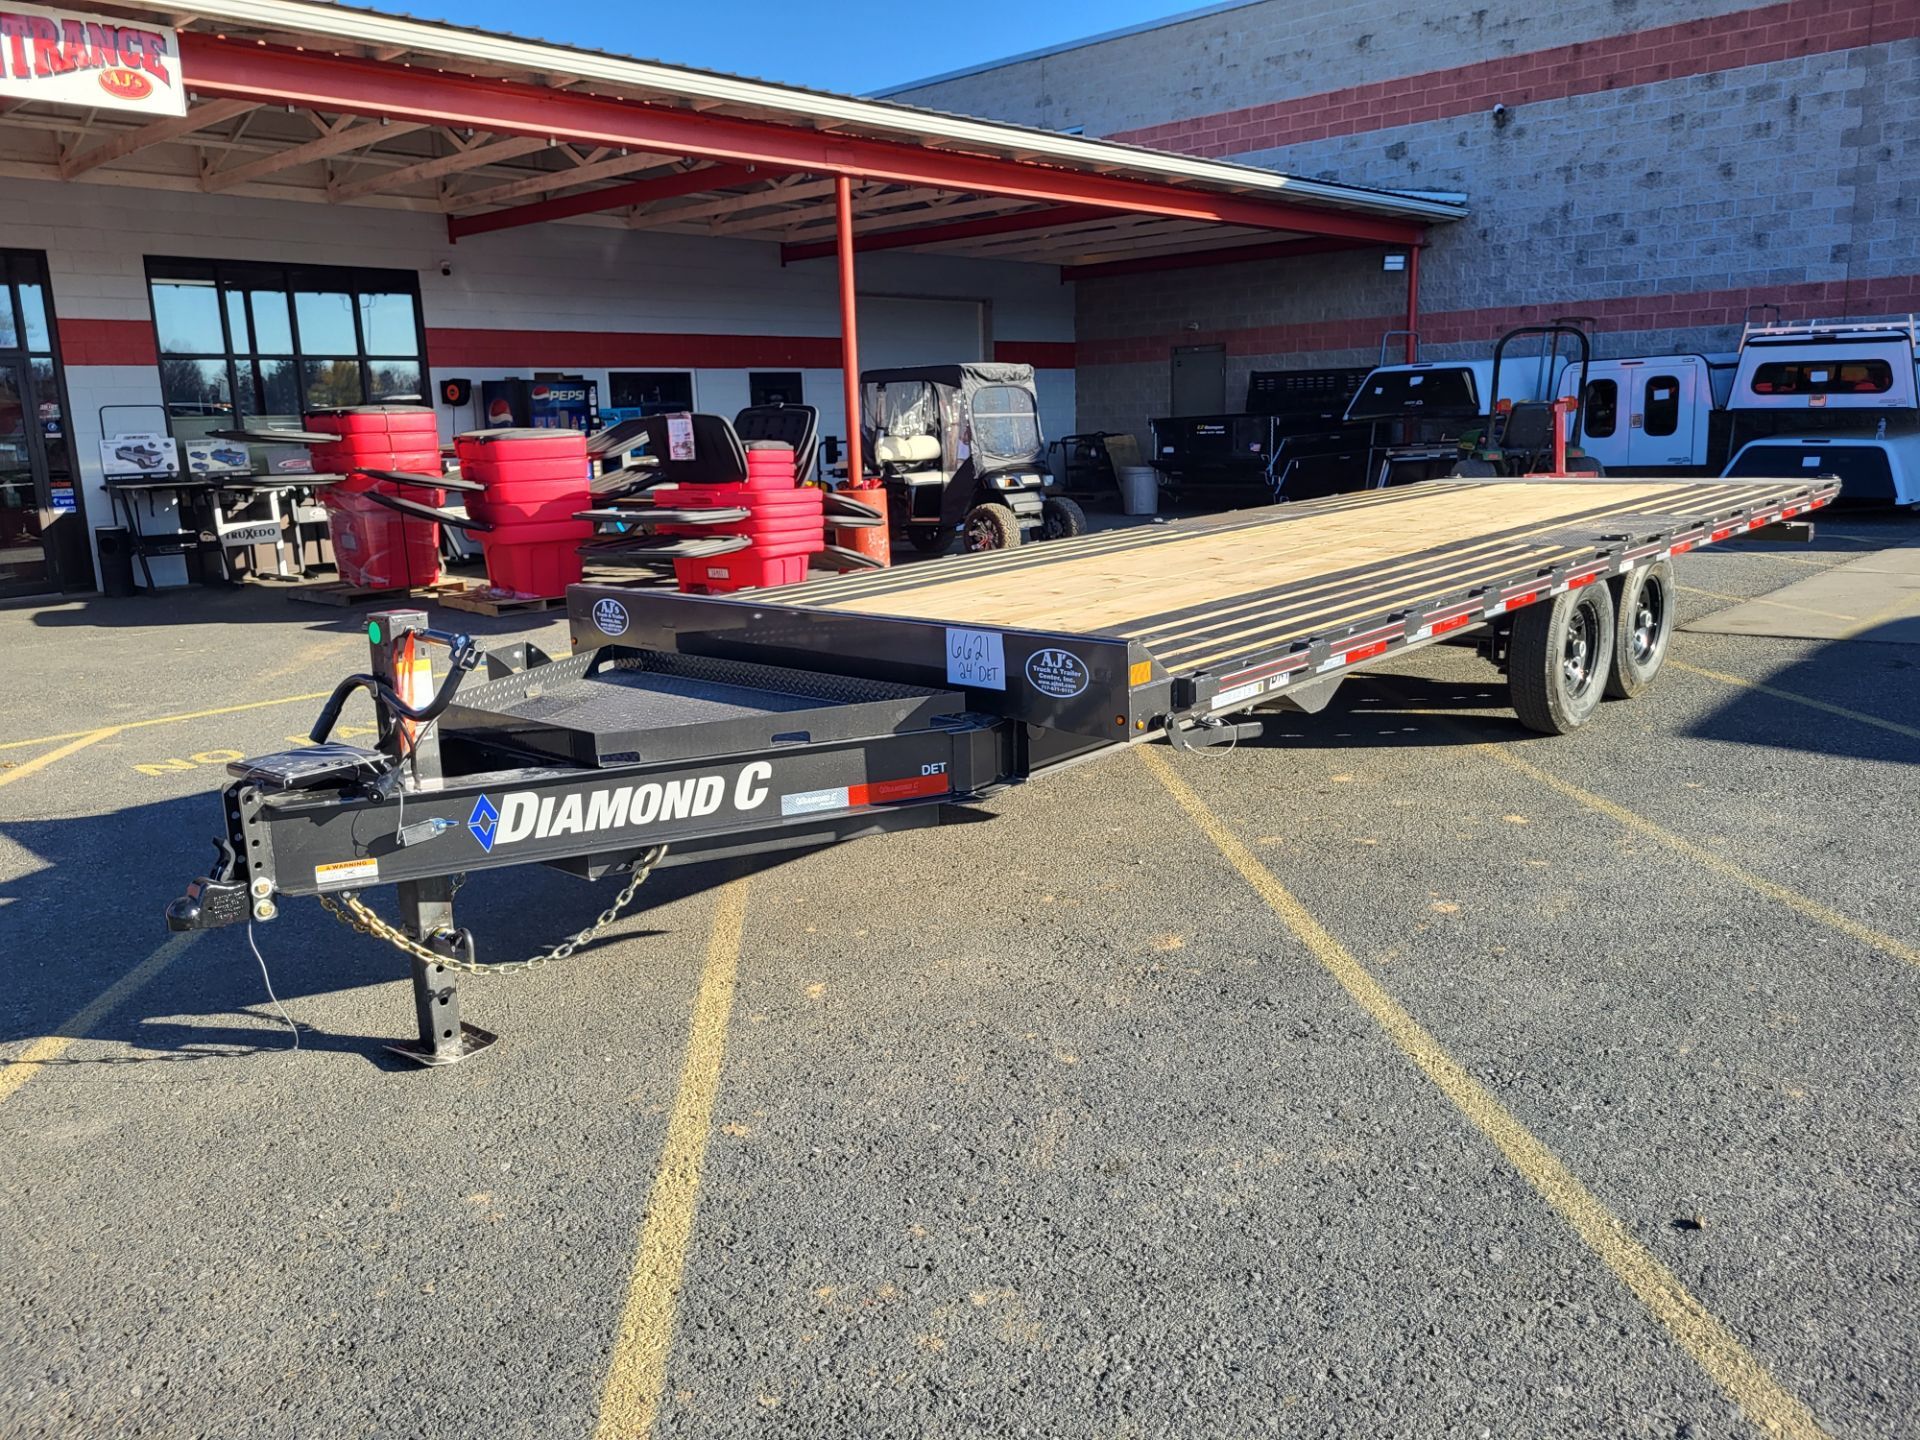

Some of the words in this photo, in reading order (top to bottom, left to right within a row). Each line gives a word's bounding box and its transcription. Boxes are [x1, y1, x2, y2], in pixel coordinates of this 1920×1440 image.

[0, 12, 171, 88] TRANCE
[549, 390, 585, 400] PEPSI
[225, 528, 276, 540] TRUXEDO
[601, 601, 619, 613] AJ's
[951, 633, 990, 663] 6621
[1041, 651, 1073, 669] AJ's
[978, 665, 1000, 682] DET
[1033, 665, 1052, 673] Truck
[1060, 669, 1081, 677] Trailer
[133, 750, 244, 776] NO
[922, 762, 947, 776] DET
[494, 776, 725, 845] DIAMOND
[734, 761, 773, 811] C
[332, 861, 367, 870] WARNING
